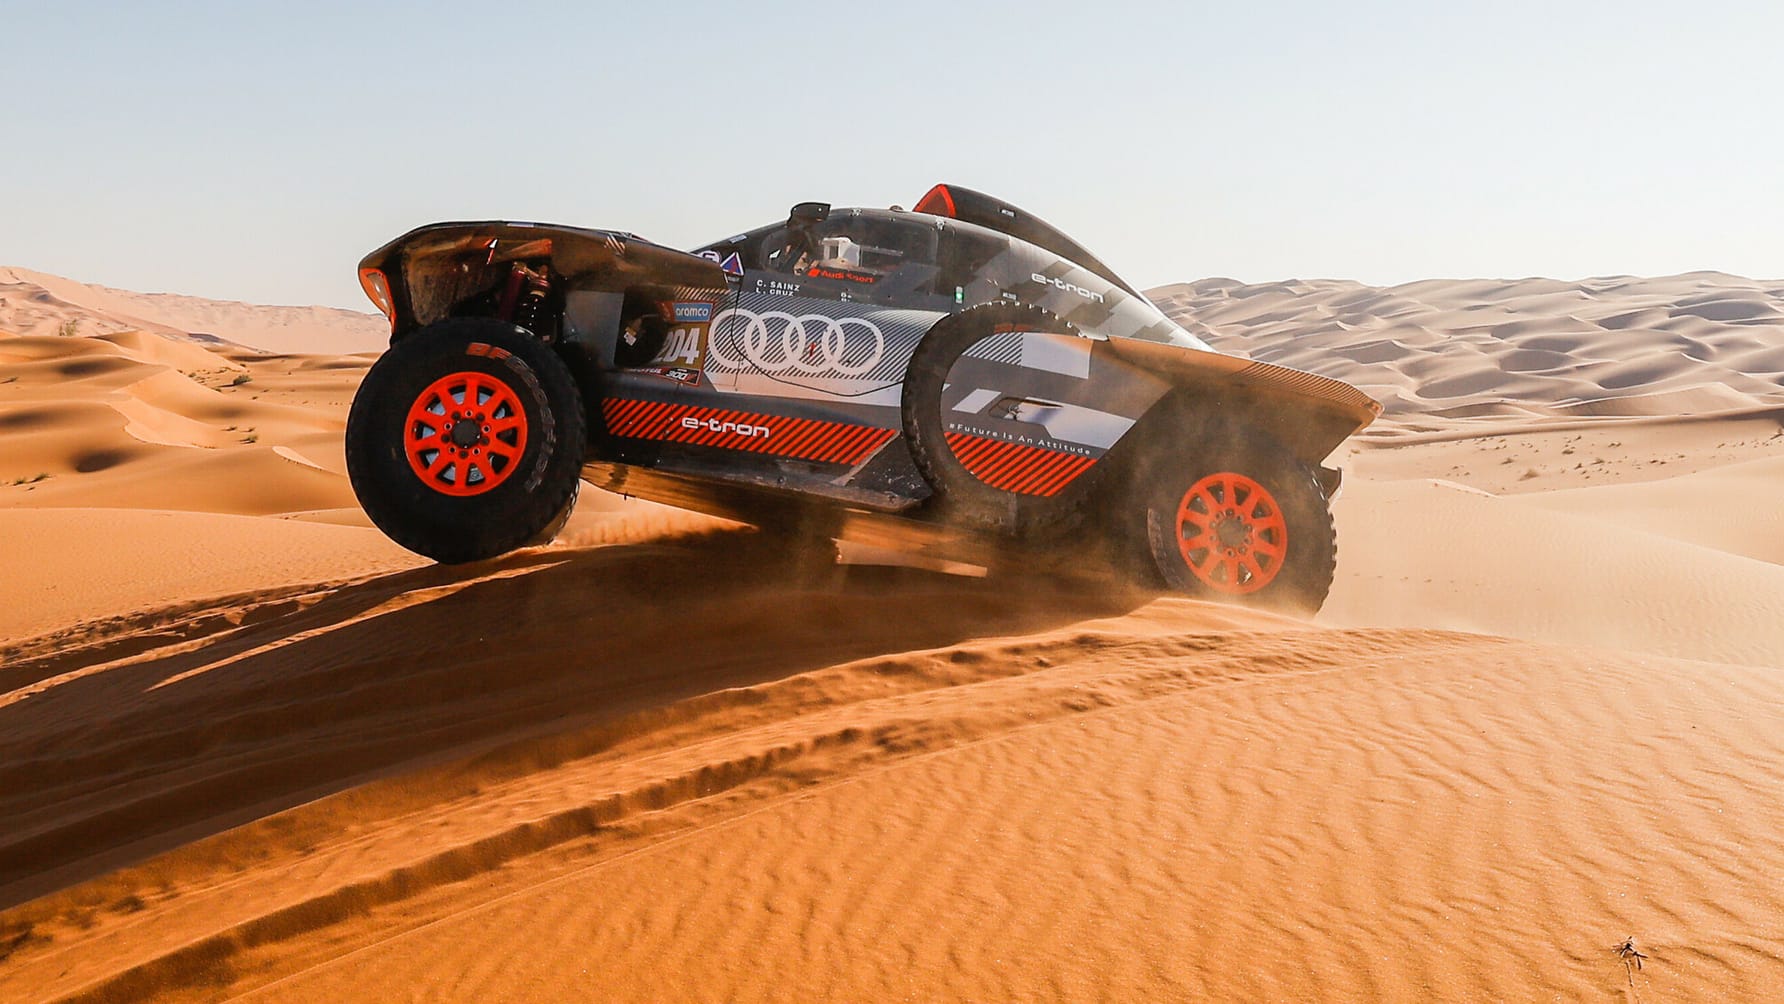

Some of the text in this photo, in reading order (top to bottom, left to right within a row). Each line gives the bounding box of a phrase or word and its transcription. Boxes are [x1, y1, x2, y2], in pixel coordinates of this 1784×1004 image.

[821, 271, 845, 279] Audi
[755, 287, 794, 297] L. CRUZ
[756, 279, 801, 292] C. SAINZ
[1031, 272, 1105, 304] e-tron
[675, 307, 709, 317] aramco
[681, 416, 770, 438] e-tron
[949, 422, 1091, 456] #Future Is An Attitude
